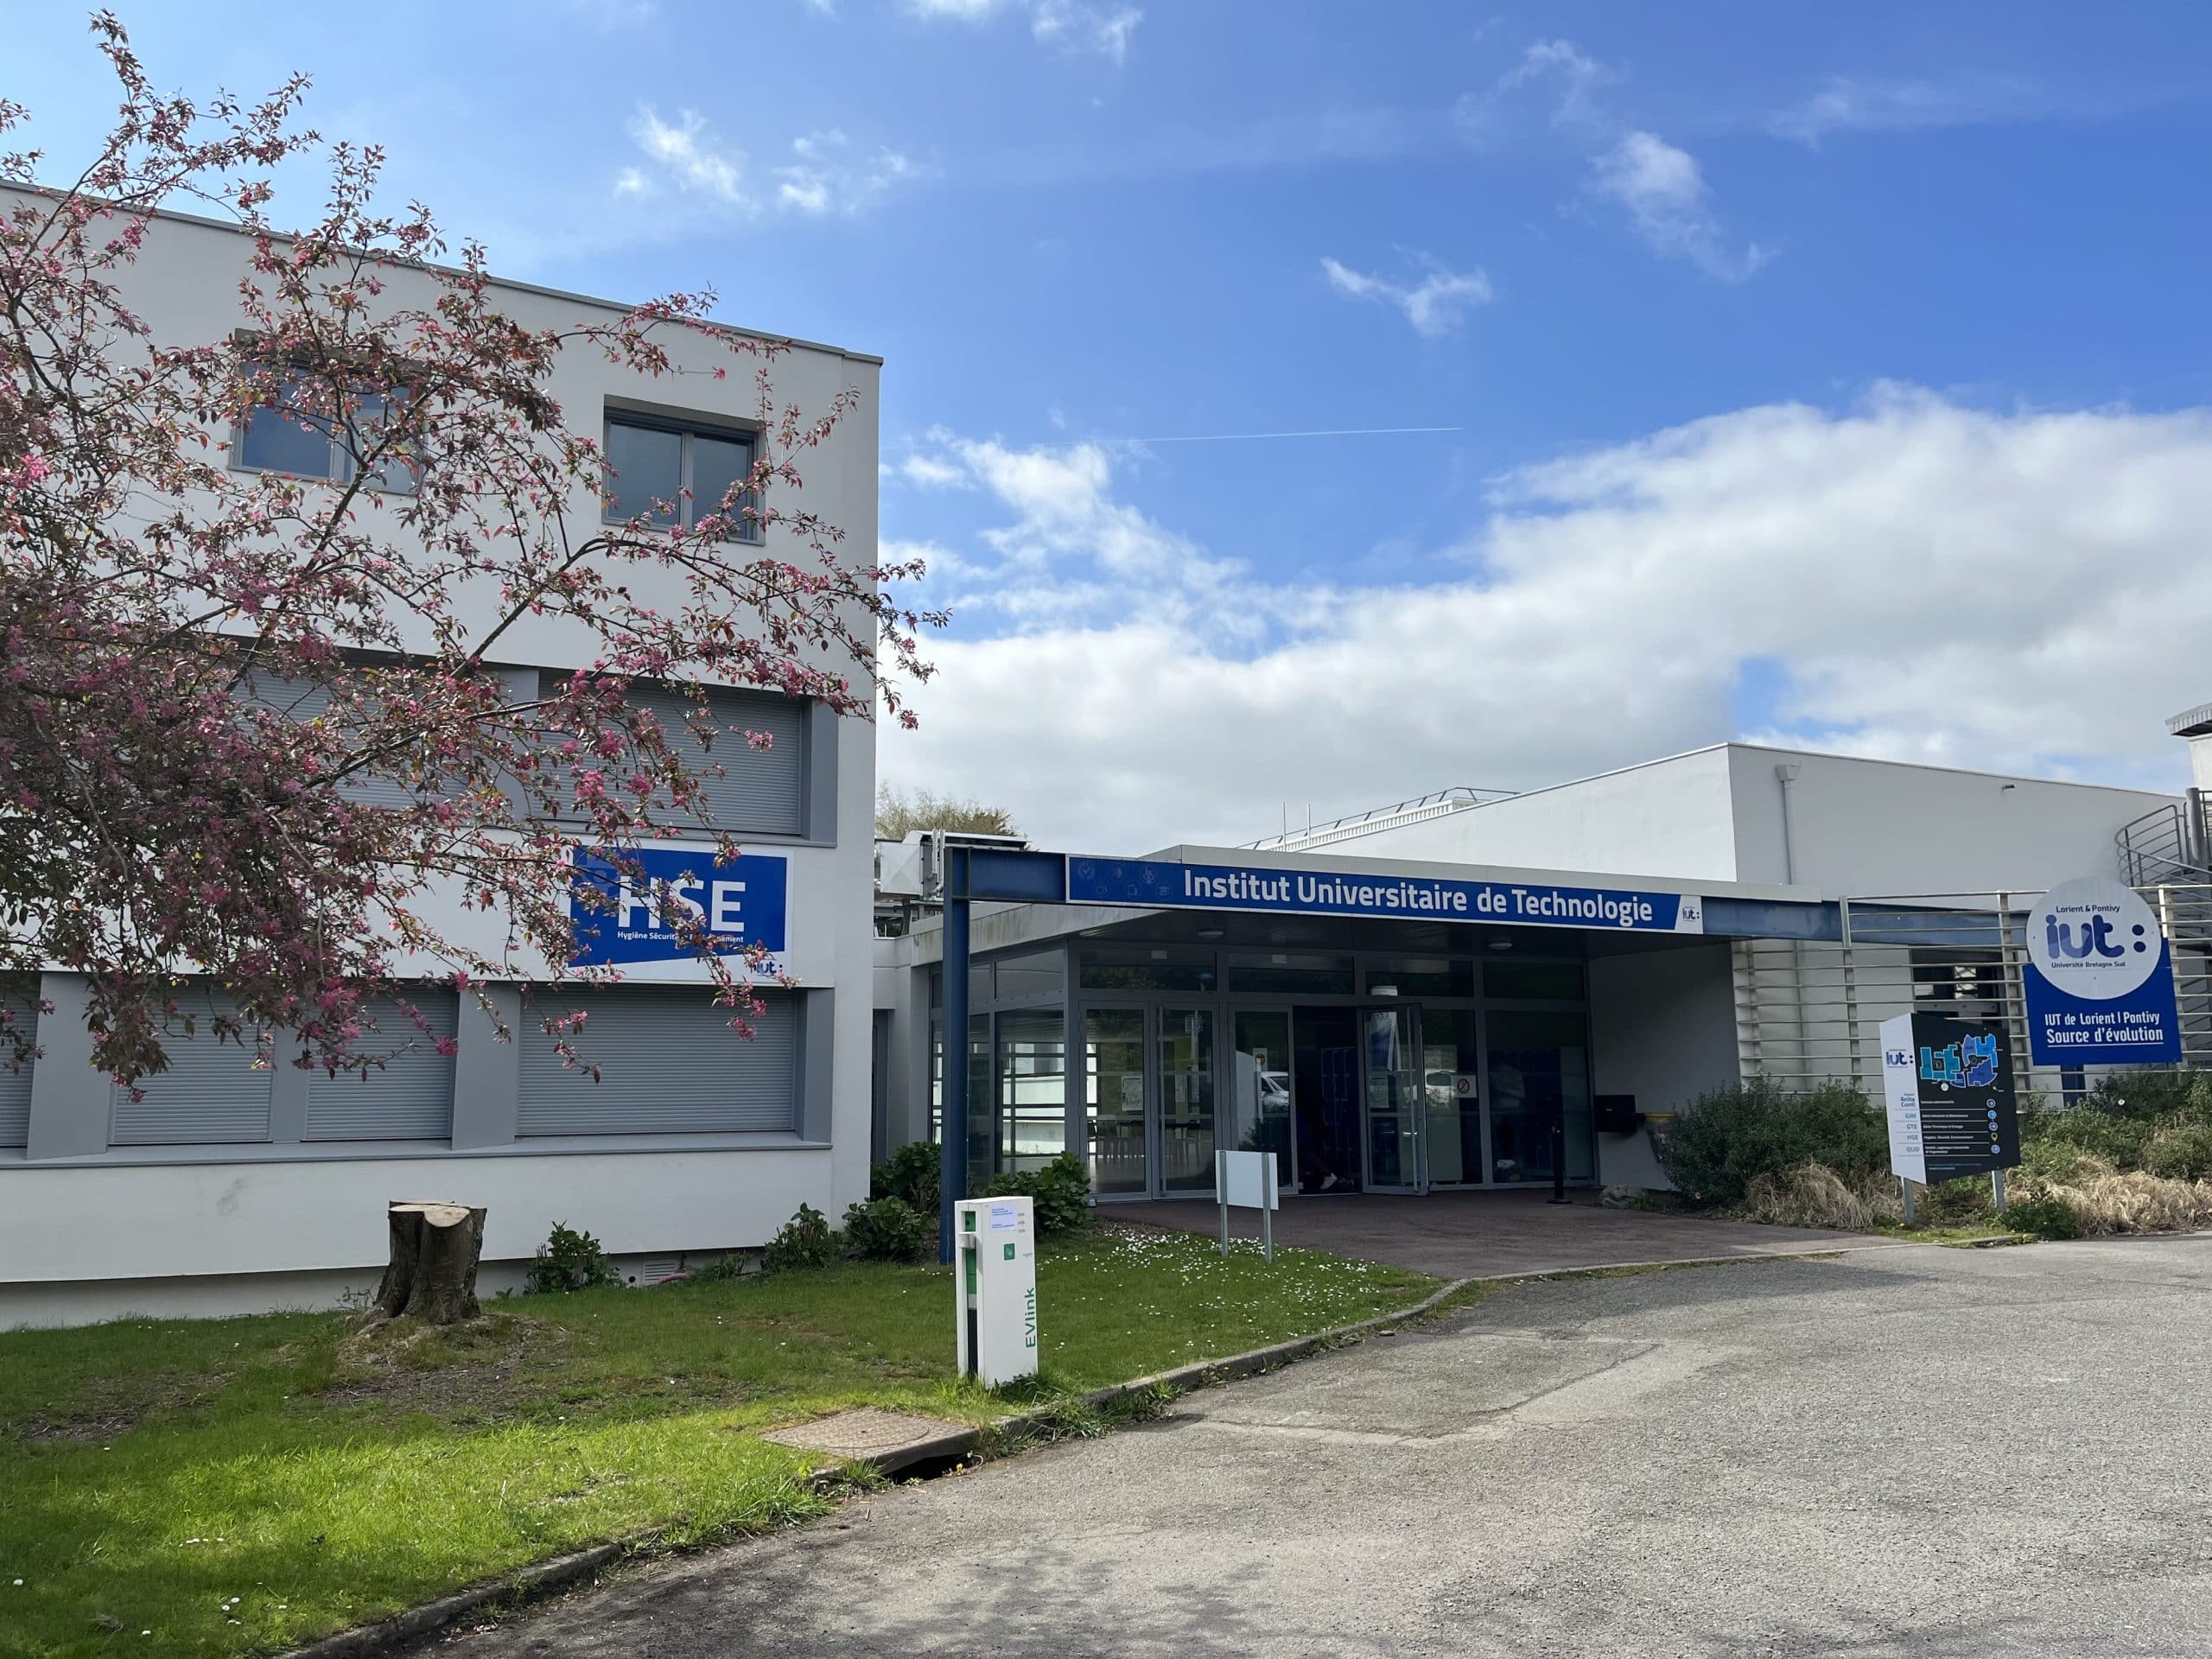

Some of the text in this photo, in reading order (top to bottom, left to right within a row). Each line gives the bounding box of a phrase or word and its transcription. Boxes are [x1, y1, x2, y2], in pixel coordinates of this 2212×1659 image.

[618, 875, 746, 932] HSE
[1185, 869, 1653, 927] Institut Universitaire de Technologie
[2092, 904, 2120, 912] Pontivy
[617, 931, 648, 940] Hygiène
[649, 931, 681, 941] Sécurit
[2044, 1014, 2062, 1026] IUT
[2064, 1013, 2076, 1025] de
[2079, 1012, 2115, 1025] Lorient
[2123, 1011, 2160, 1025] Pontivy
[2046, 1026, 2164, 1044] Source d'évolution
[1024, 1287, 1036, 1348] EVlink
